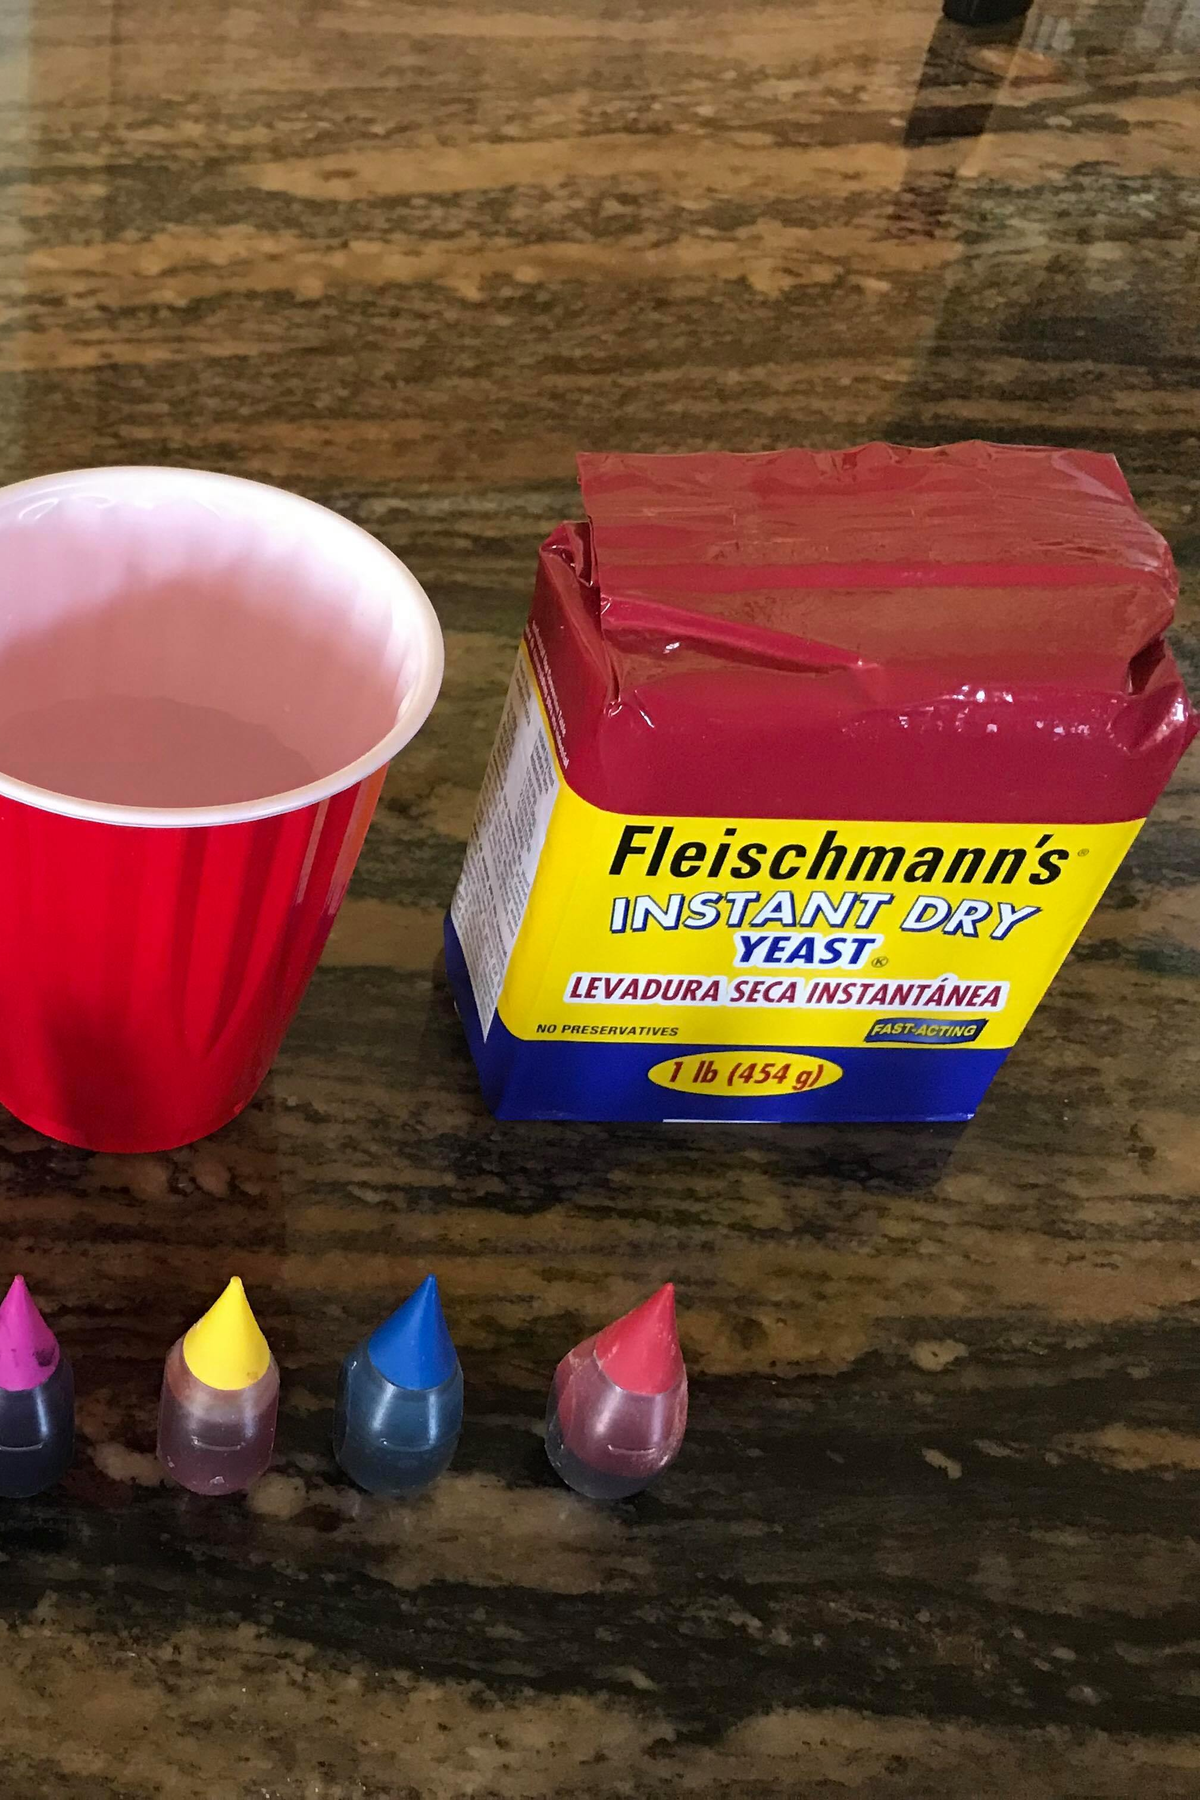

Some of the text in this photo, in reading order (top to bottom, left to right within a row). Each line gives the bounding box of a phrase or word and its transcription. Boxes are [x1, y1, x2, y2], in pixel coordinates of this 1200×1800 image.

[608, 824, 1070, 885] Fleischmann's
[610, 890, 1042, 941] INSTANT DRY
[738, 933, 877, 966] YEAST
[569, 976, 1002, 1008] LEVADURA SECA INSTANTÁNEA
[536, 1022, 978, 1038] NO PRESERVATIVES FAST-ACTING
[669, 1061, 824, 1092] 1 lb (454 g)
